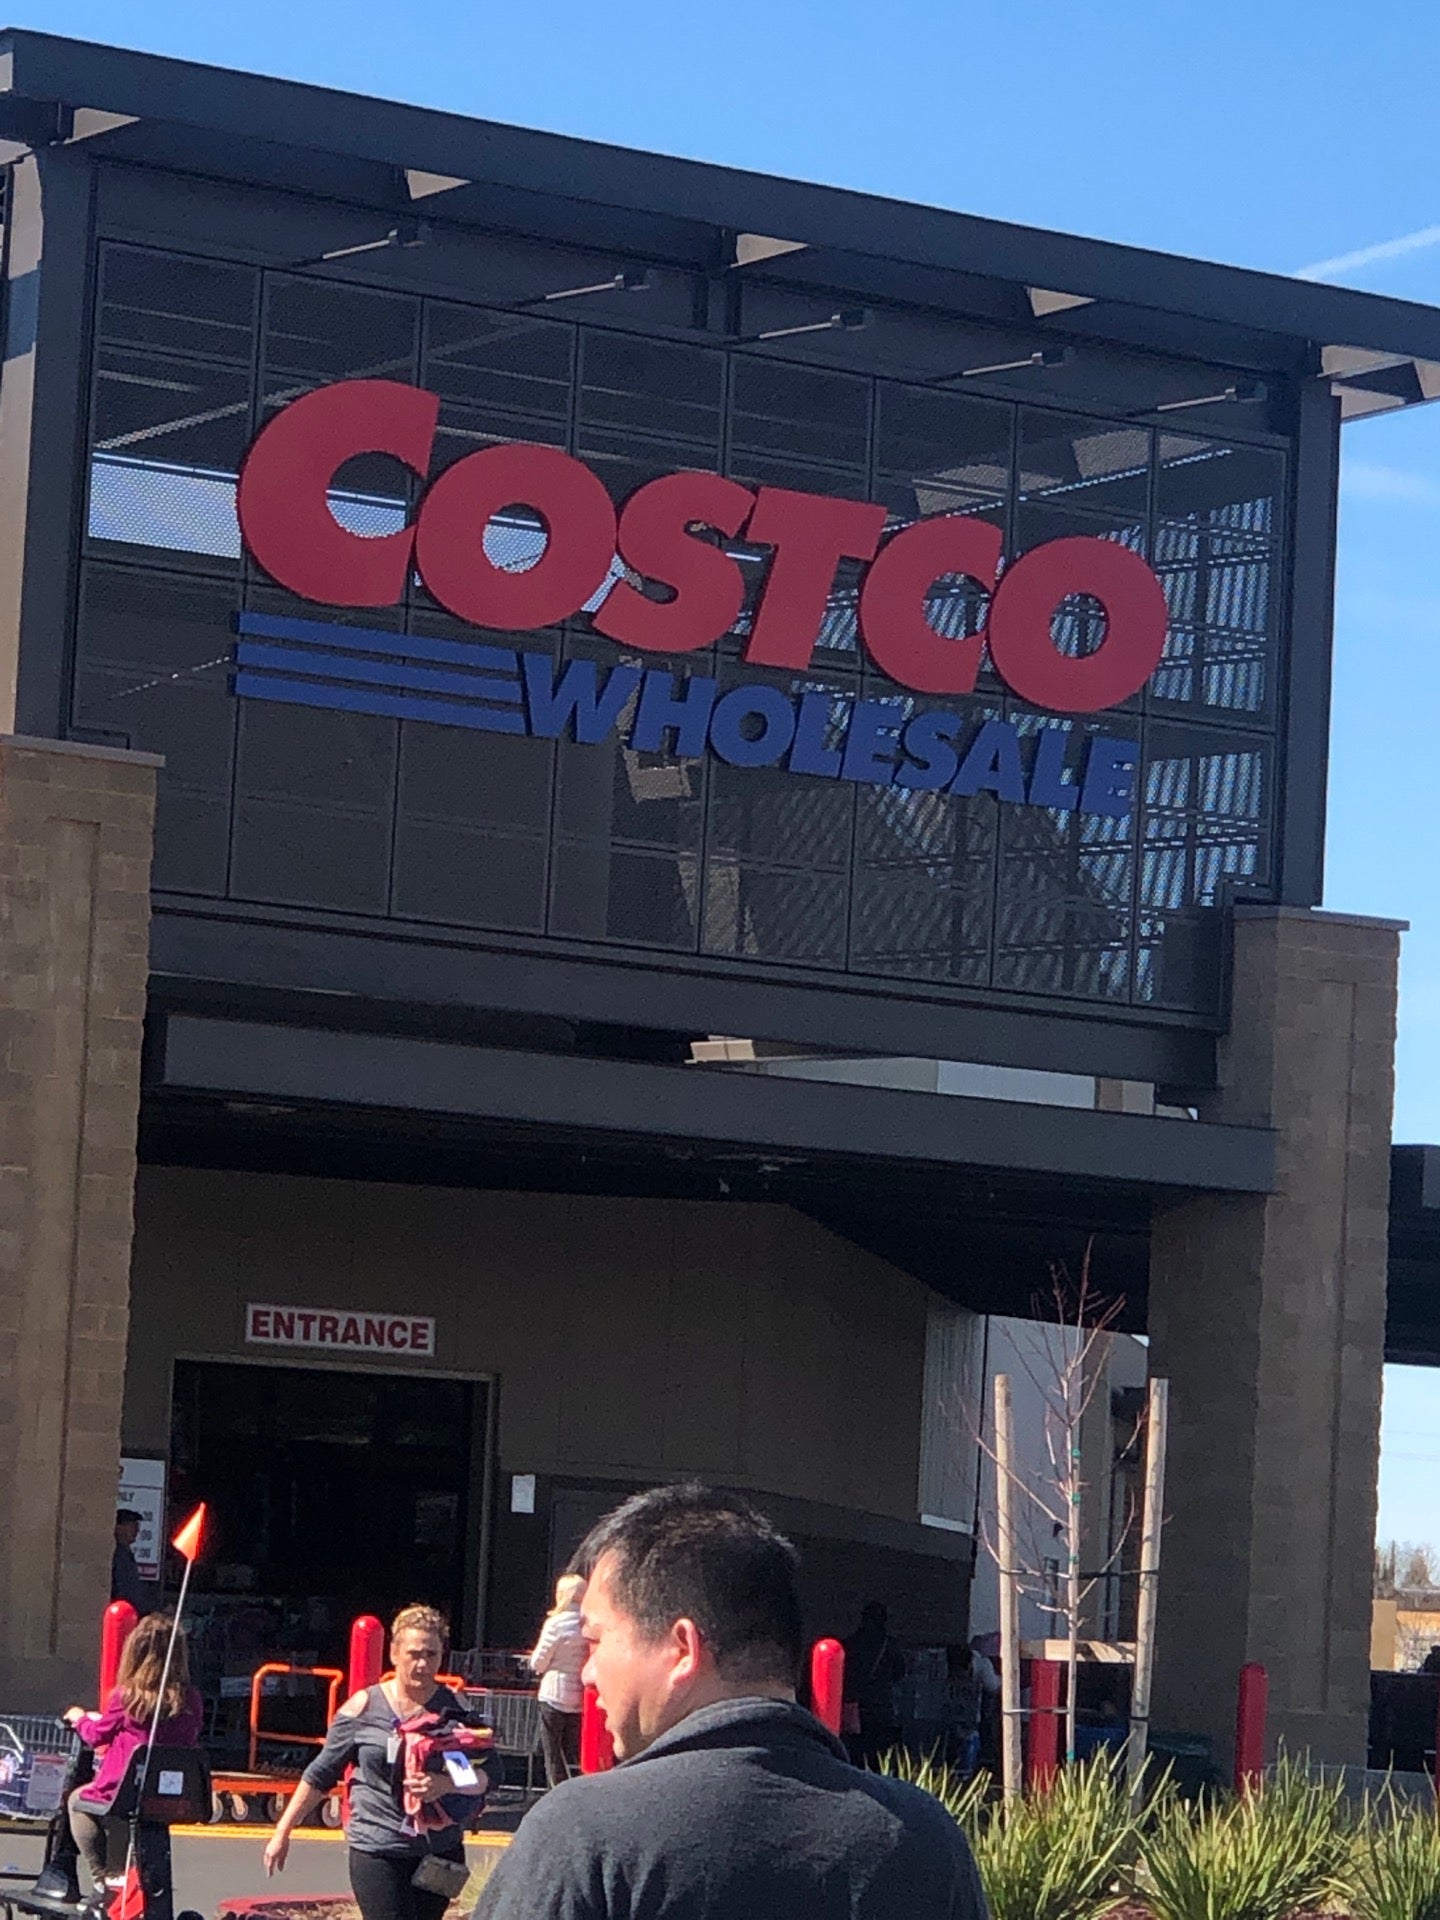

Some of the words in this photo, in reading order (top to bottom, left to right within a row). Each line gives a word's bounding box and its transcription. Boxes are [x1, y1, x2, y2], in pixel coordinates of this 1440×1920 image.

[237, 380, 1168, 713] COSTCO
[522, 650, 1141, 818] WHOLESALE
[252, 1309, 429, 1350] ENTRANCE
